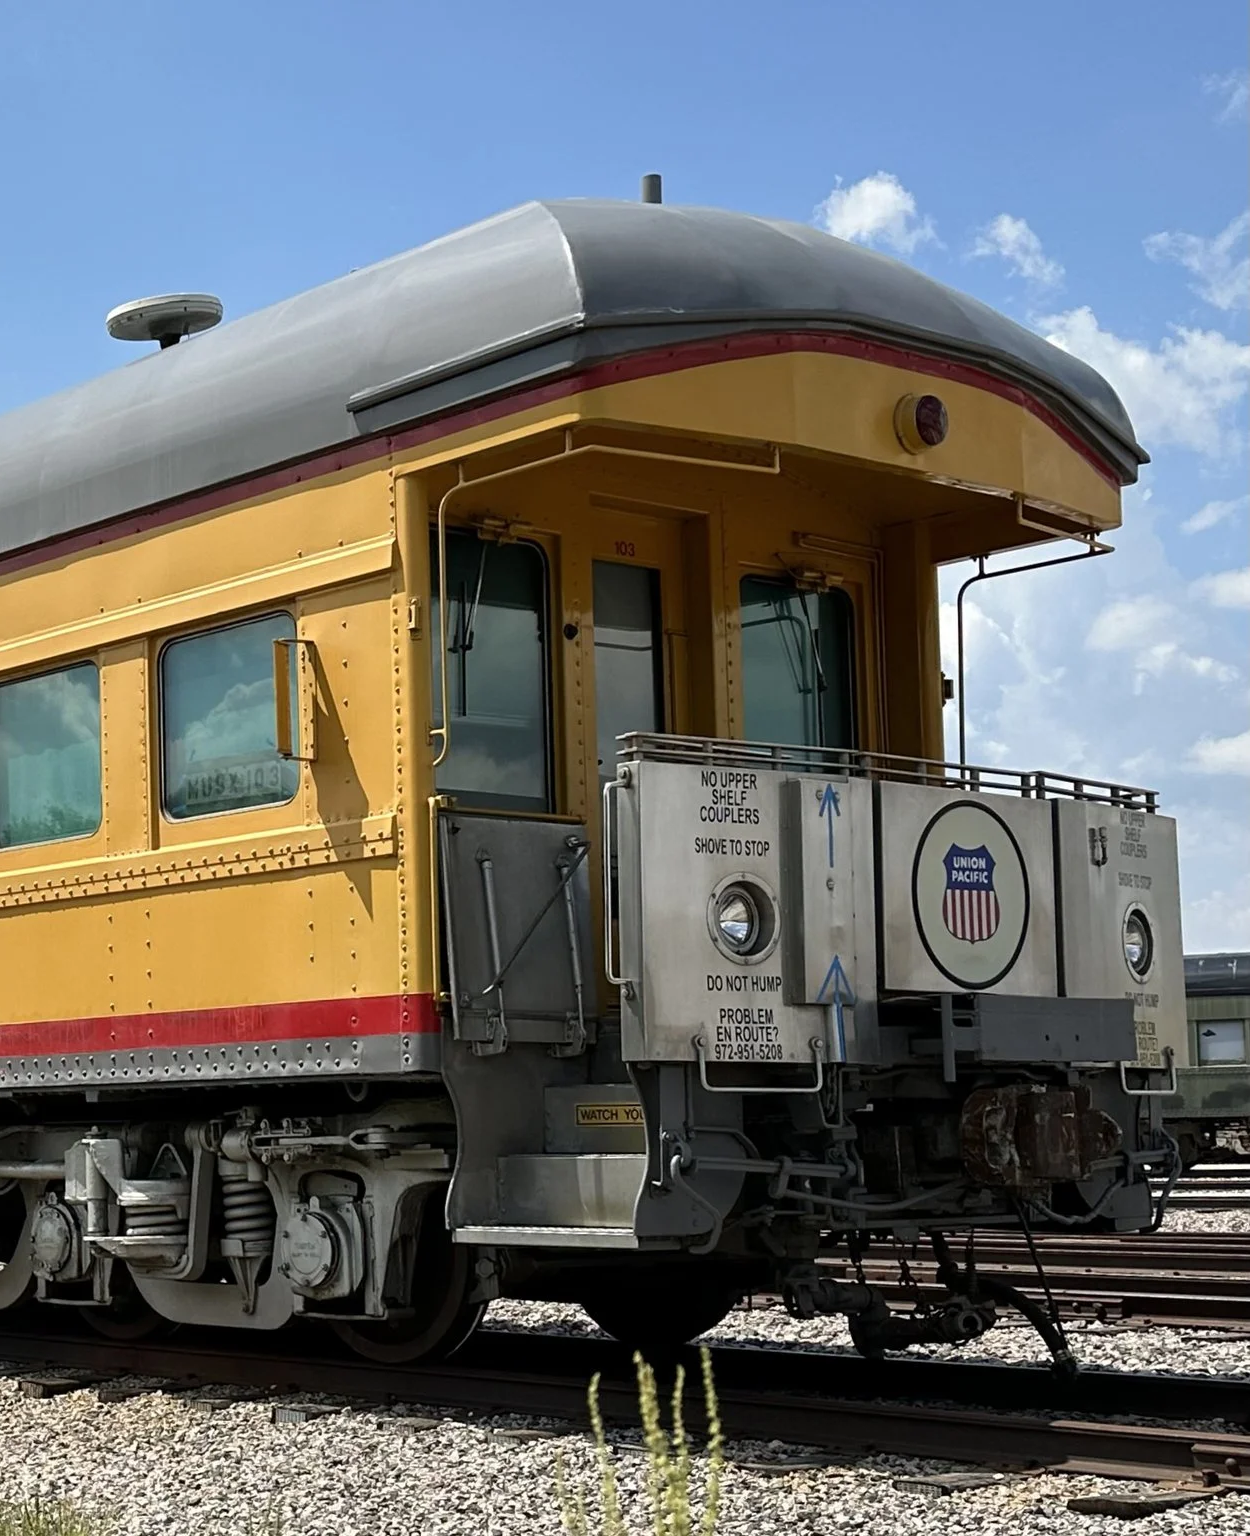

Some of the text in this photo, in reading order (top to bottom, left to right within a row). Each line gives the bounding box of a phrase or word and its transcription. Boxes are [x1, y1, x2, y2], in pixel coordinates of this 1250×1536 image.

[614, 541, 635, 557] 103
[701, 770, 758, 790] NO UPPER
[712, 788, 747, 806] SHELF
[700, 805, 760, 825] COUPLERS
[694, 836, 770, 857] SHOVE TO STOP
[953, 856, 986, 869] UNION
[951, 870, 989, 884] PACIFIC
[706, 974, 782, 992] DO NOT HUMP
[719, 1008, 774, 1025] PROBLEM
[716, 1025, 779, 1042] EN ROUTE?
[714, 1043, 783, 1060] 972-951-5208
[580, 1108, 618, 1121] WATCH
